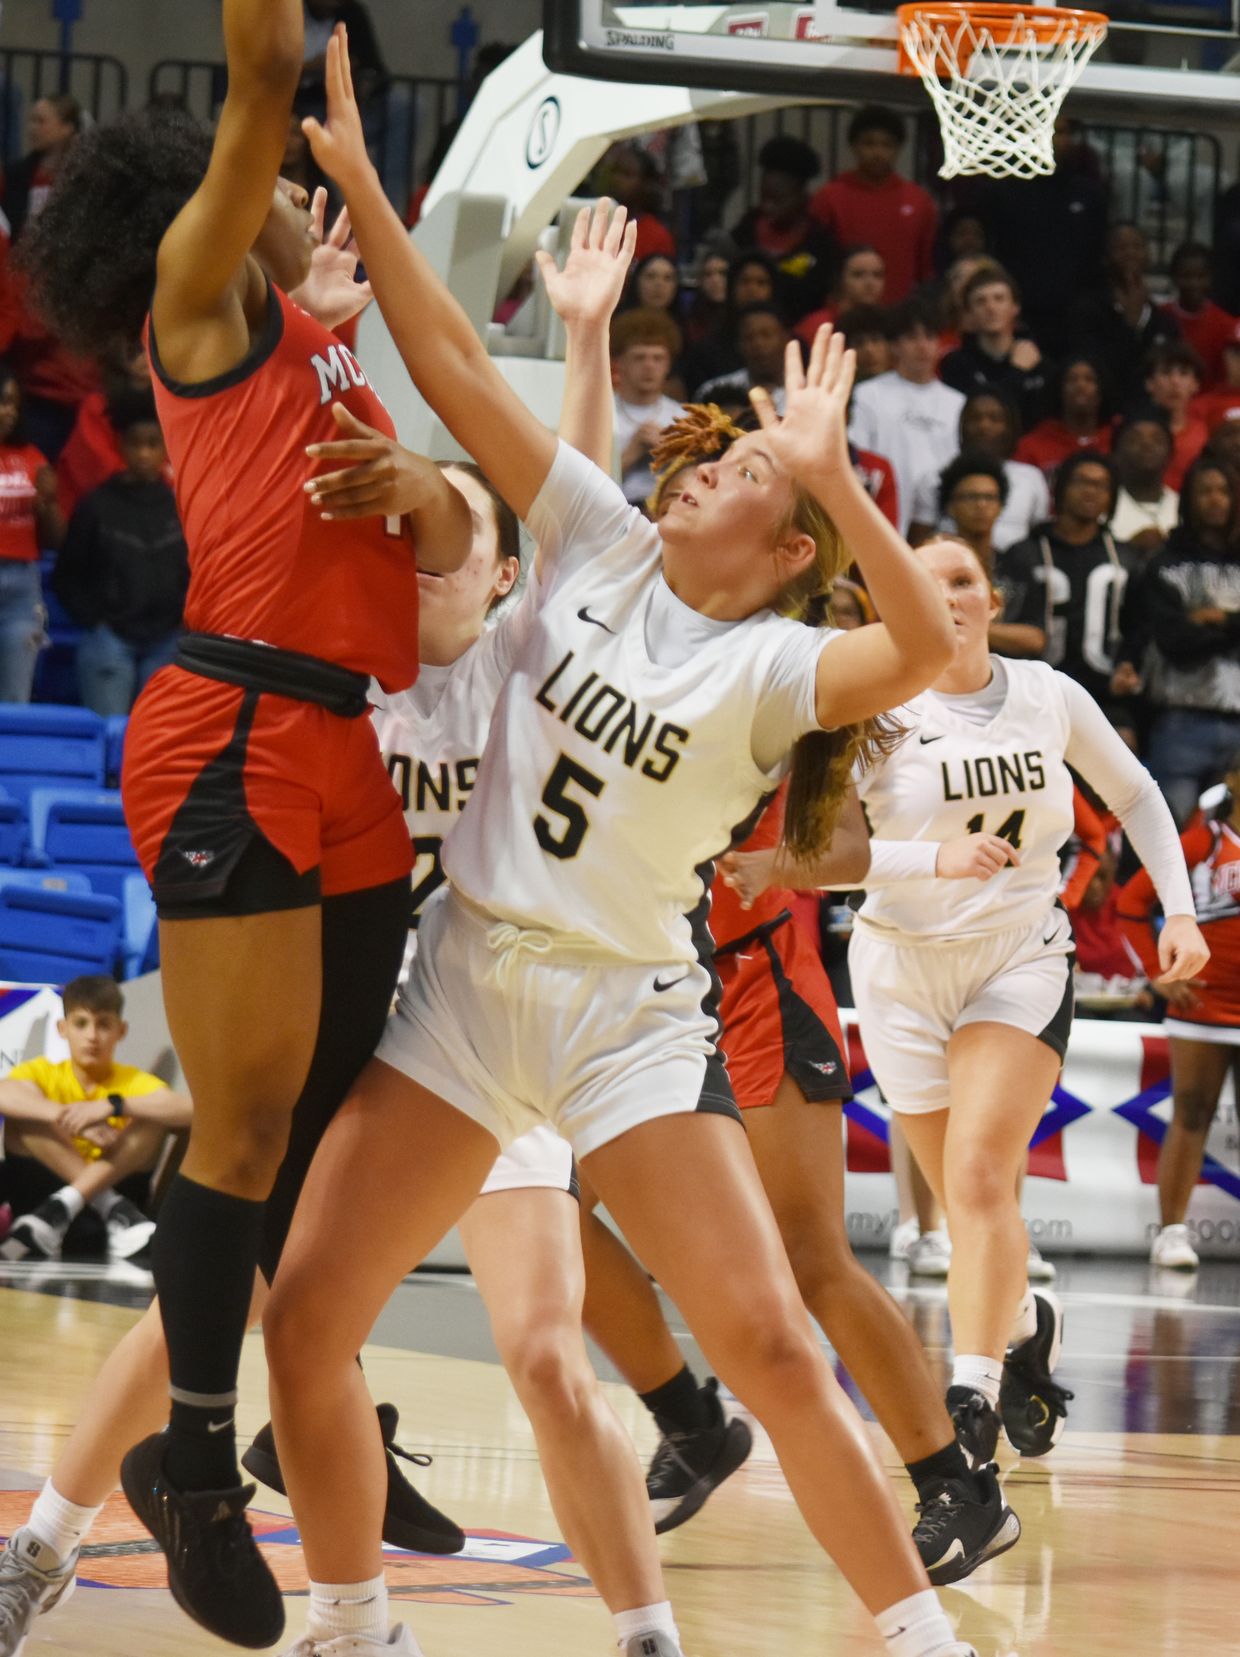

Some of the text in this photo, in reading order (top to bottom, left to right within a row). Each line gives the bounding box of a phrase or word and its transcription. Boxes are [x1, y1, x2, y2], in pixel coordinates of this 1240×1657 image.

[606, 30, 674, 50] SPALDING
[310, 343, 382, 405] MC
[535, 650, 690, 784] LIONS
[387, 754, 480, 812] ONS
[533, 751, 606, 860] 5
[941, 750, 1046, 801] LIONS
